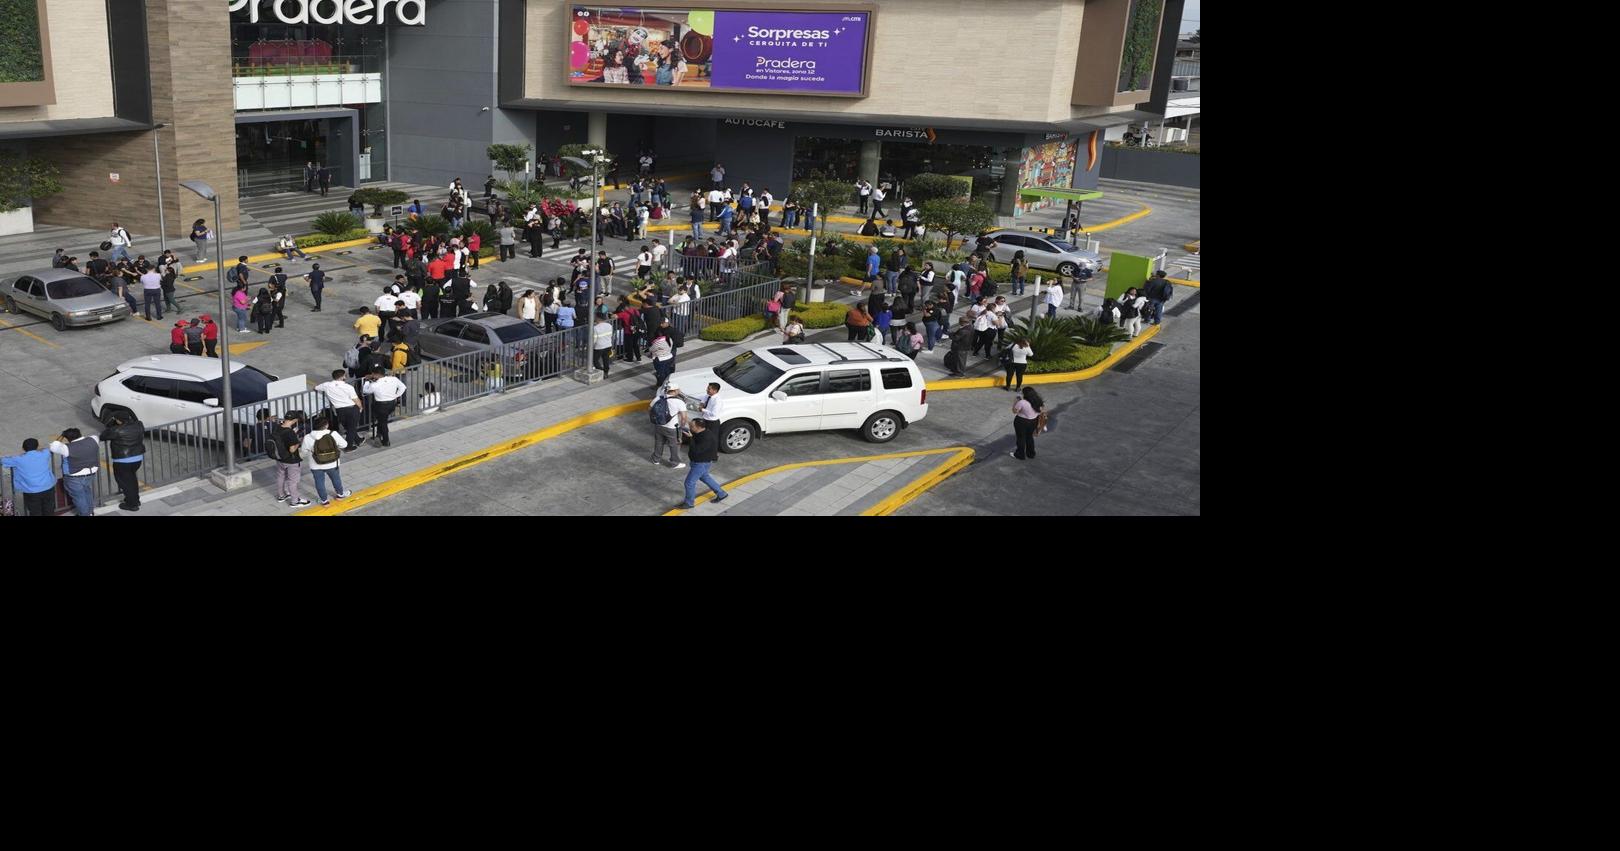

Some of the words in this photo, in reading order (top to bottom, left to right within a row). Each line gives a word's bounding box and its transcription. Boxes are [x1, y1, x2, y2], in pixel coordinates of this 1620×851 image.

[229, 0, 426, 25] radera
[748, 26, 830, 41] Sorpresas
[756, 56, 816, 69] Pradera
[875, 129, 928, 139] BARISTA
